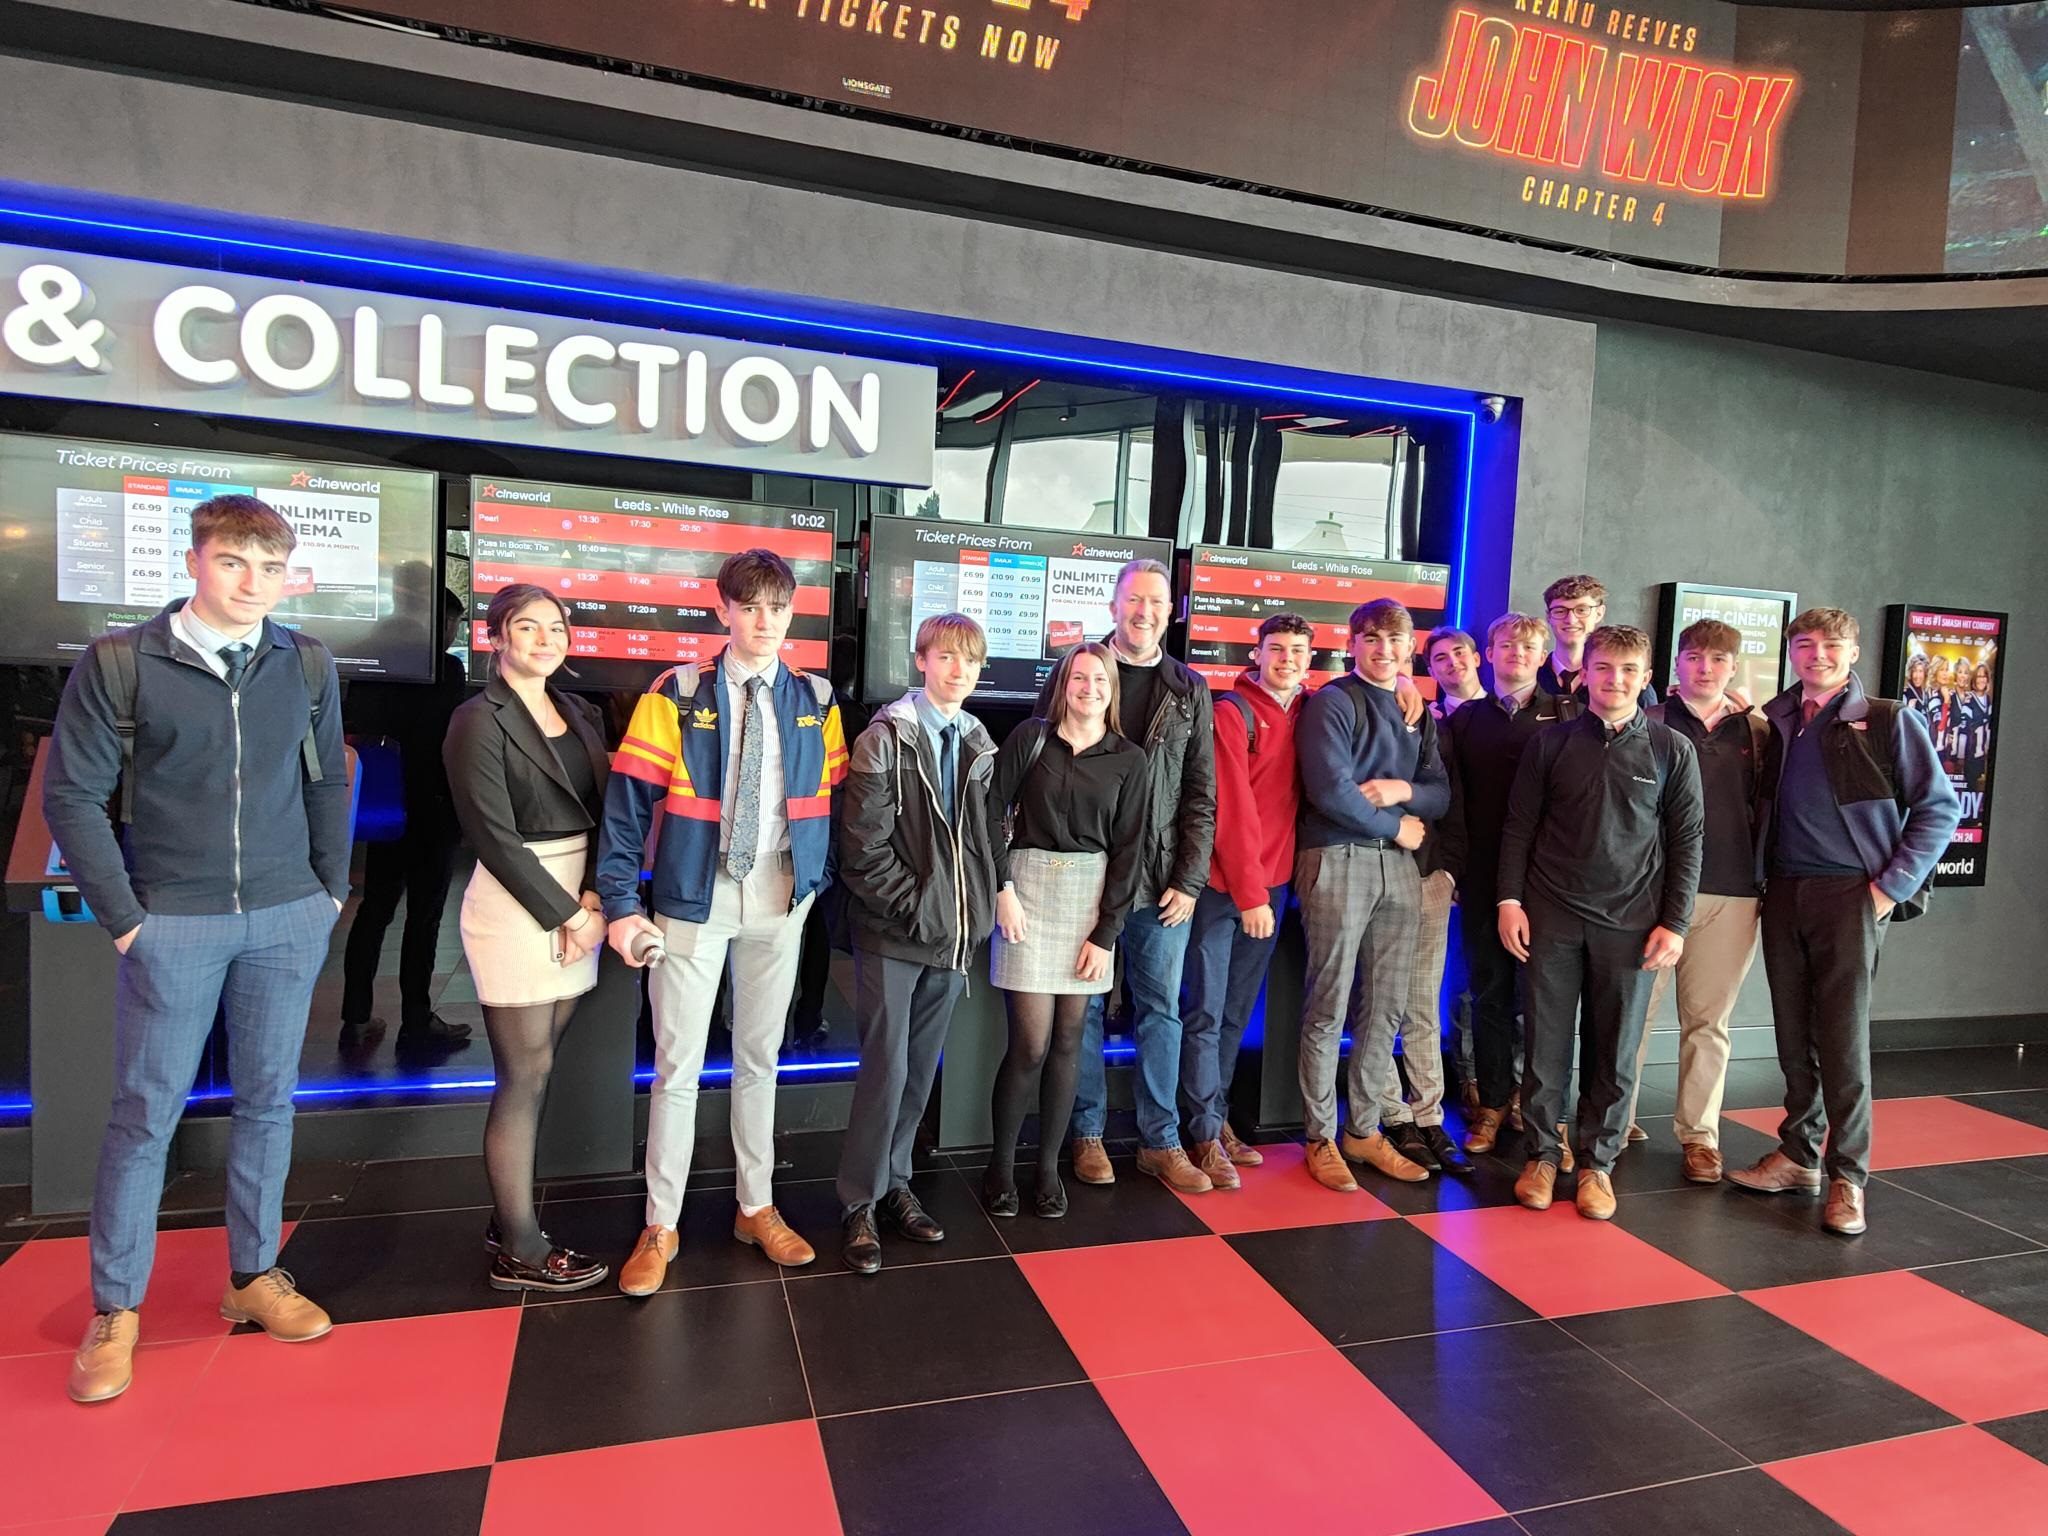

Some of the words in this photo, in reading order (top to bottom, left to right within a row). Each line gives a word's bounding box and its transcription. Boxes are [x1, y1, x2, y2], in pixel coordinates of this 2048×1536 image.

[1606, 10, 1697, 52] REEVES
[981, 24, 1060, 70] NOW
[842, 77, 892, 94] LIONSGATE
[1409, 10, 1607, 168] JOHN
[1602, 52, 1793, 197] WICK
[1522, 176, 1636, 222] CHAPTER
[1653, 202, 1665, 227] 4
[3, 264, 105, 369] &
[153, 285, 880, 453] COLLECTION
[57, 450, 118, 469] Ticket
[119, 456, 177, 474] Prices
[181, 462, 231, 479] From
[308, 477, 380, 494] cineworld
[495, 489, 551, 502] cineworld
[132, 503, 162, 512] £6.99
[614, 498, 651, 511] Leeds
[662, 502, 696, 516] White
[699, 505, 729, 519] Rose
[479, 514, 499, 522] Pearl
[578, 515, 599, 523] 13:30
[630, 519, 651, 528] 17:30
[680, 523, 701, 532] 20:50
[790, 513, 825, 528] 10:02
[132, 525, 162, 533] £6.99
[294, 523, 342, 538] EMA
[73, 539, 109, 548] Student
[132, 547, 162, 556] £6.99
[478, 539, 497, 547] Puss
[915, 529, 956, 545] Ticket
[957, 533, 997, 548] Prices
[998, 537, 1032, 551] From
[496, 550, 515, 558] Wish
[1083, 547, 1133, 559] cineworld
[1210, 555, 1248, 565] cineworld
[132, 570, 162, 578] £6.99
[1291, 560, 1318, 571] Leeds
[1325, 563, 1349, 574] White
[1350, 565, 1373, 576] Rose
[1417, 569, 1442, 582] 10:02
[577, 573, 598, 581] 13:20
[679, 580, 699, 589] 19:50
[1021, 575, 1041, 583] £9.99
[1053, 570, 1118, 584] UNLIMITE
[990, 591, 1013, 599] £10.99
[1020, 593, 1040, 601] £9.99
[1052, 584, 1104, 597] CINEMA
[576, 602, 598, 610] 13:50
[628, 605, 649, 614] 17:20
[677, 608, 698, 616] 20:10
[962, 607, 982, 615] £6.99
[989, 609, 1012, 617] £10.99
[1724, 610, 1778, 628] CINEMA
[988, 627, 1011, 635] £10.99
[1018, 628, 1038, 636] £9.99
[1964, 833, 1974, 842] 24
[1936, 858, 1974, 874] world
